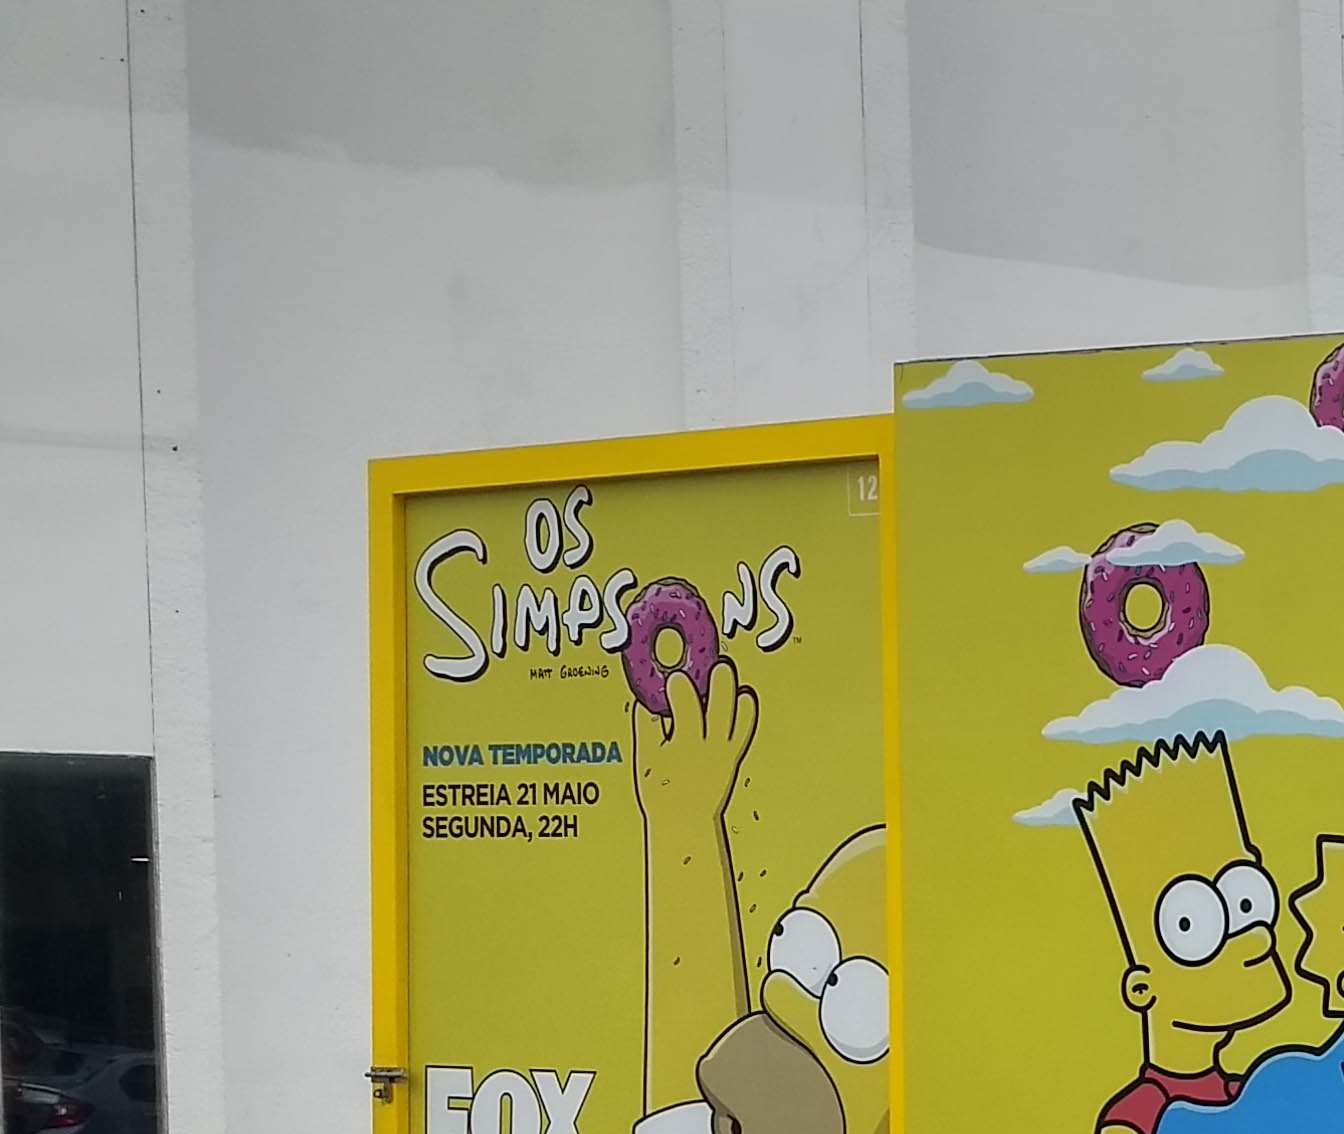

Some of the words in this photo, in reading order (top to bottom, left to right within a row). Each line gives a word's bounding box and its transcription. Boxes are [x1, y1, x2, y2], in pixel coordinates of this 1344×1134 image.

[857, 475, 878, 501] 12
[524, 485, 593, 574] OS
[530, 667, 553, 680] MATT
[560, 665, 609, 680] GROENING
[423, 745, 484, 766] NOVA
[488, 741, 623, 765] TEMPORADA
[423, 783, 511, 806] ESTREIA
[517, 782, 537, 805] 21
[544, 782, 600, 805] MAIO
[422, 815, 533, 842] SEGUNDA,
[538, 815, 578, 838] 22H
